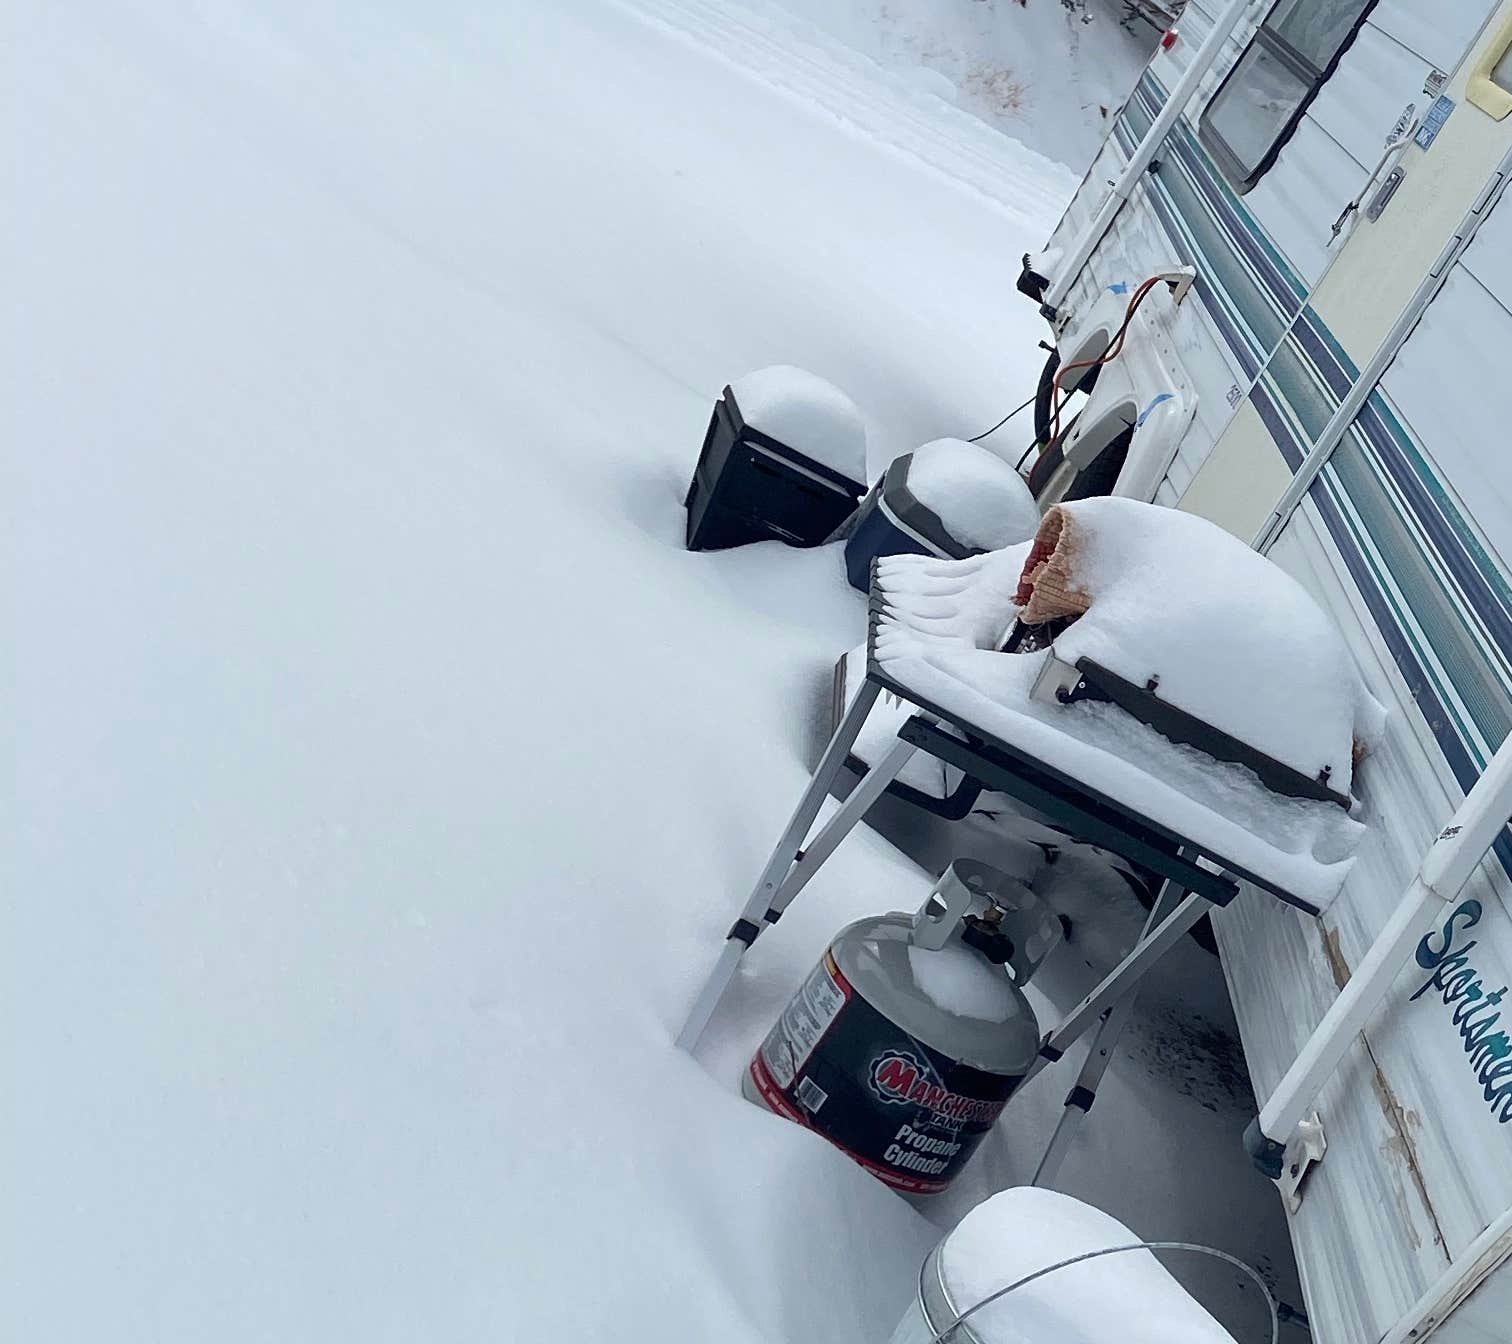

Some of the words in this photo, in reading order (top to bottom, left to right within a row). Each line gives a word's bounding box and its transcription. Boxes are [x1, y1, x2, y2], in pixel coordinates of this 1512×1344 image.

[930, 1113, 966, 1131] TANK
[895, 1124, 961, 1157] Propane
[884, 1143, 949, 1175] Cylinder
